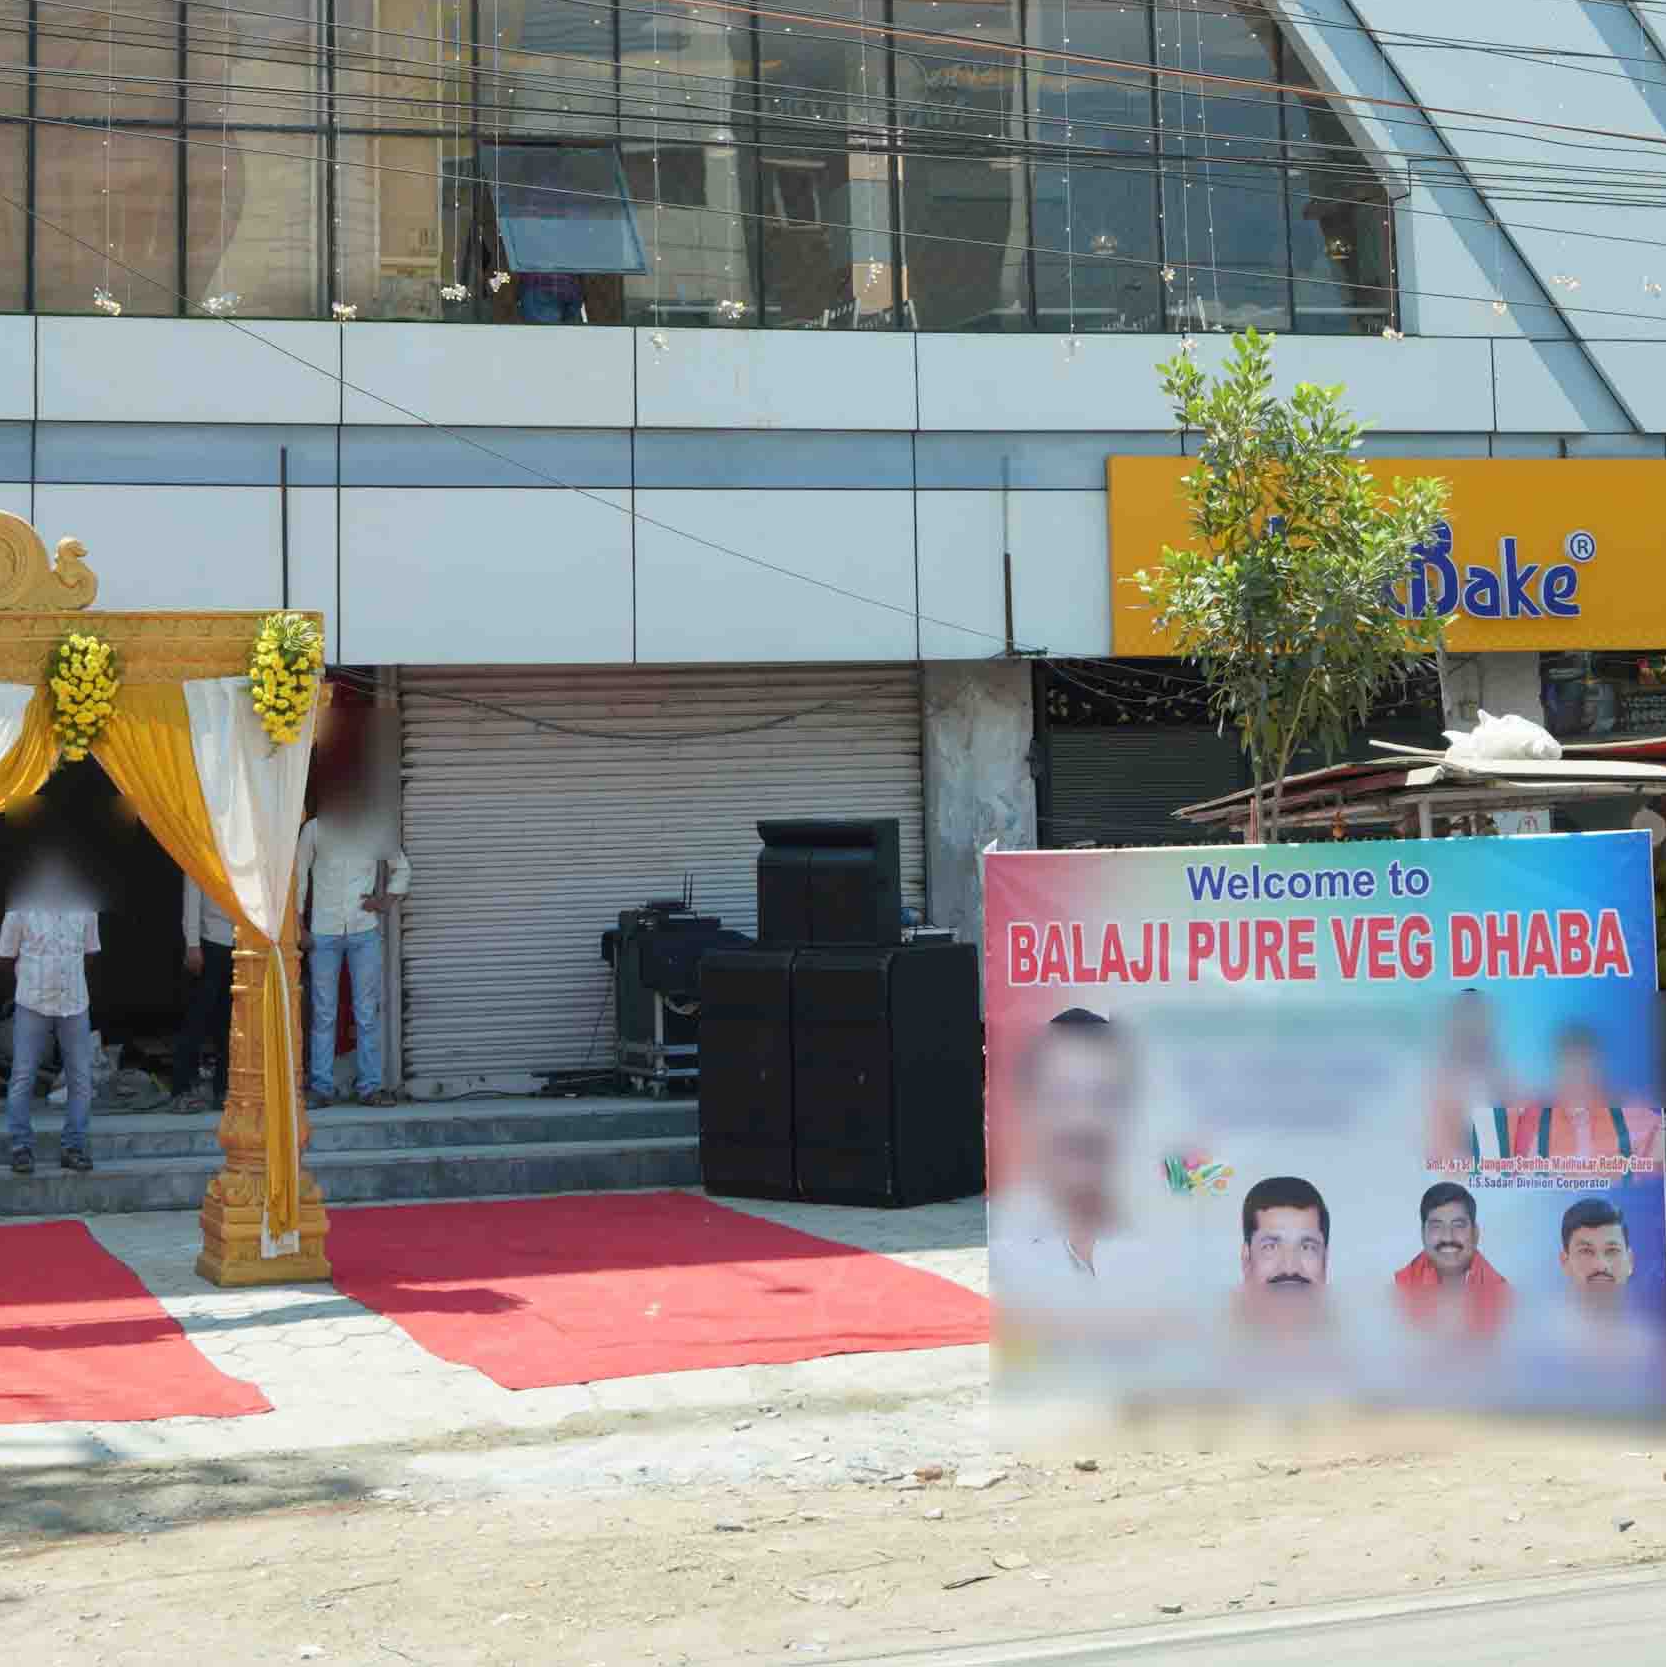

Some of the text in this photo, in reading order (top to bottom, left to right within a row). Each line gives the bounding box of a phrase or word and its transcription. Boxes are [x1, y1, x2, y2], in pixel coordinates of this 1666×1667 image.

[1388, 516, 1582, 620] Bake
[1186, 860, 1431, 902] Welcome to
[1009, 909, 1632, 985] BALAJI PURE VEG DHABA
[1516, 1176, 1554, 1189] Division
[1556, 1176, 1610, 1191] Corporator
